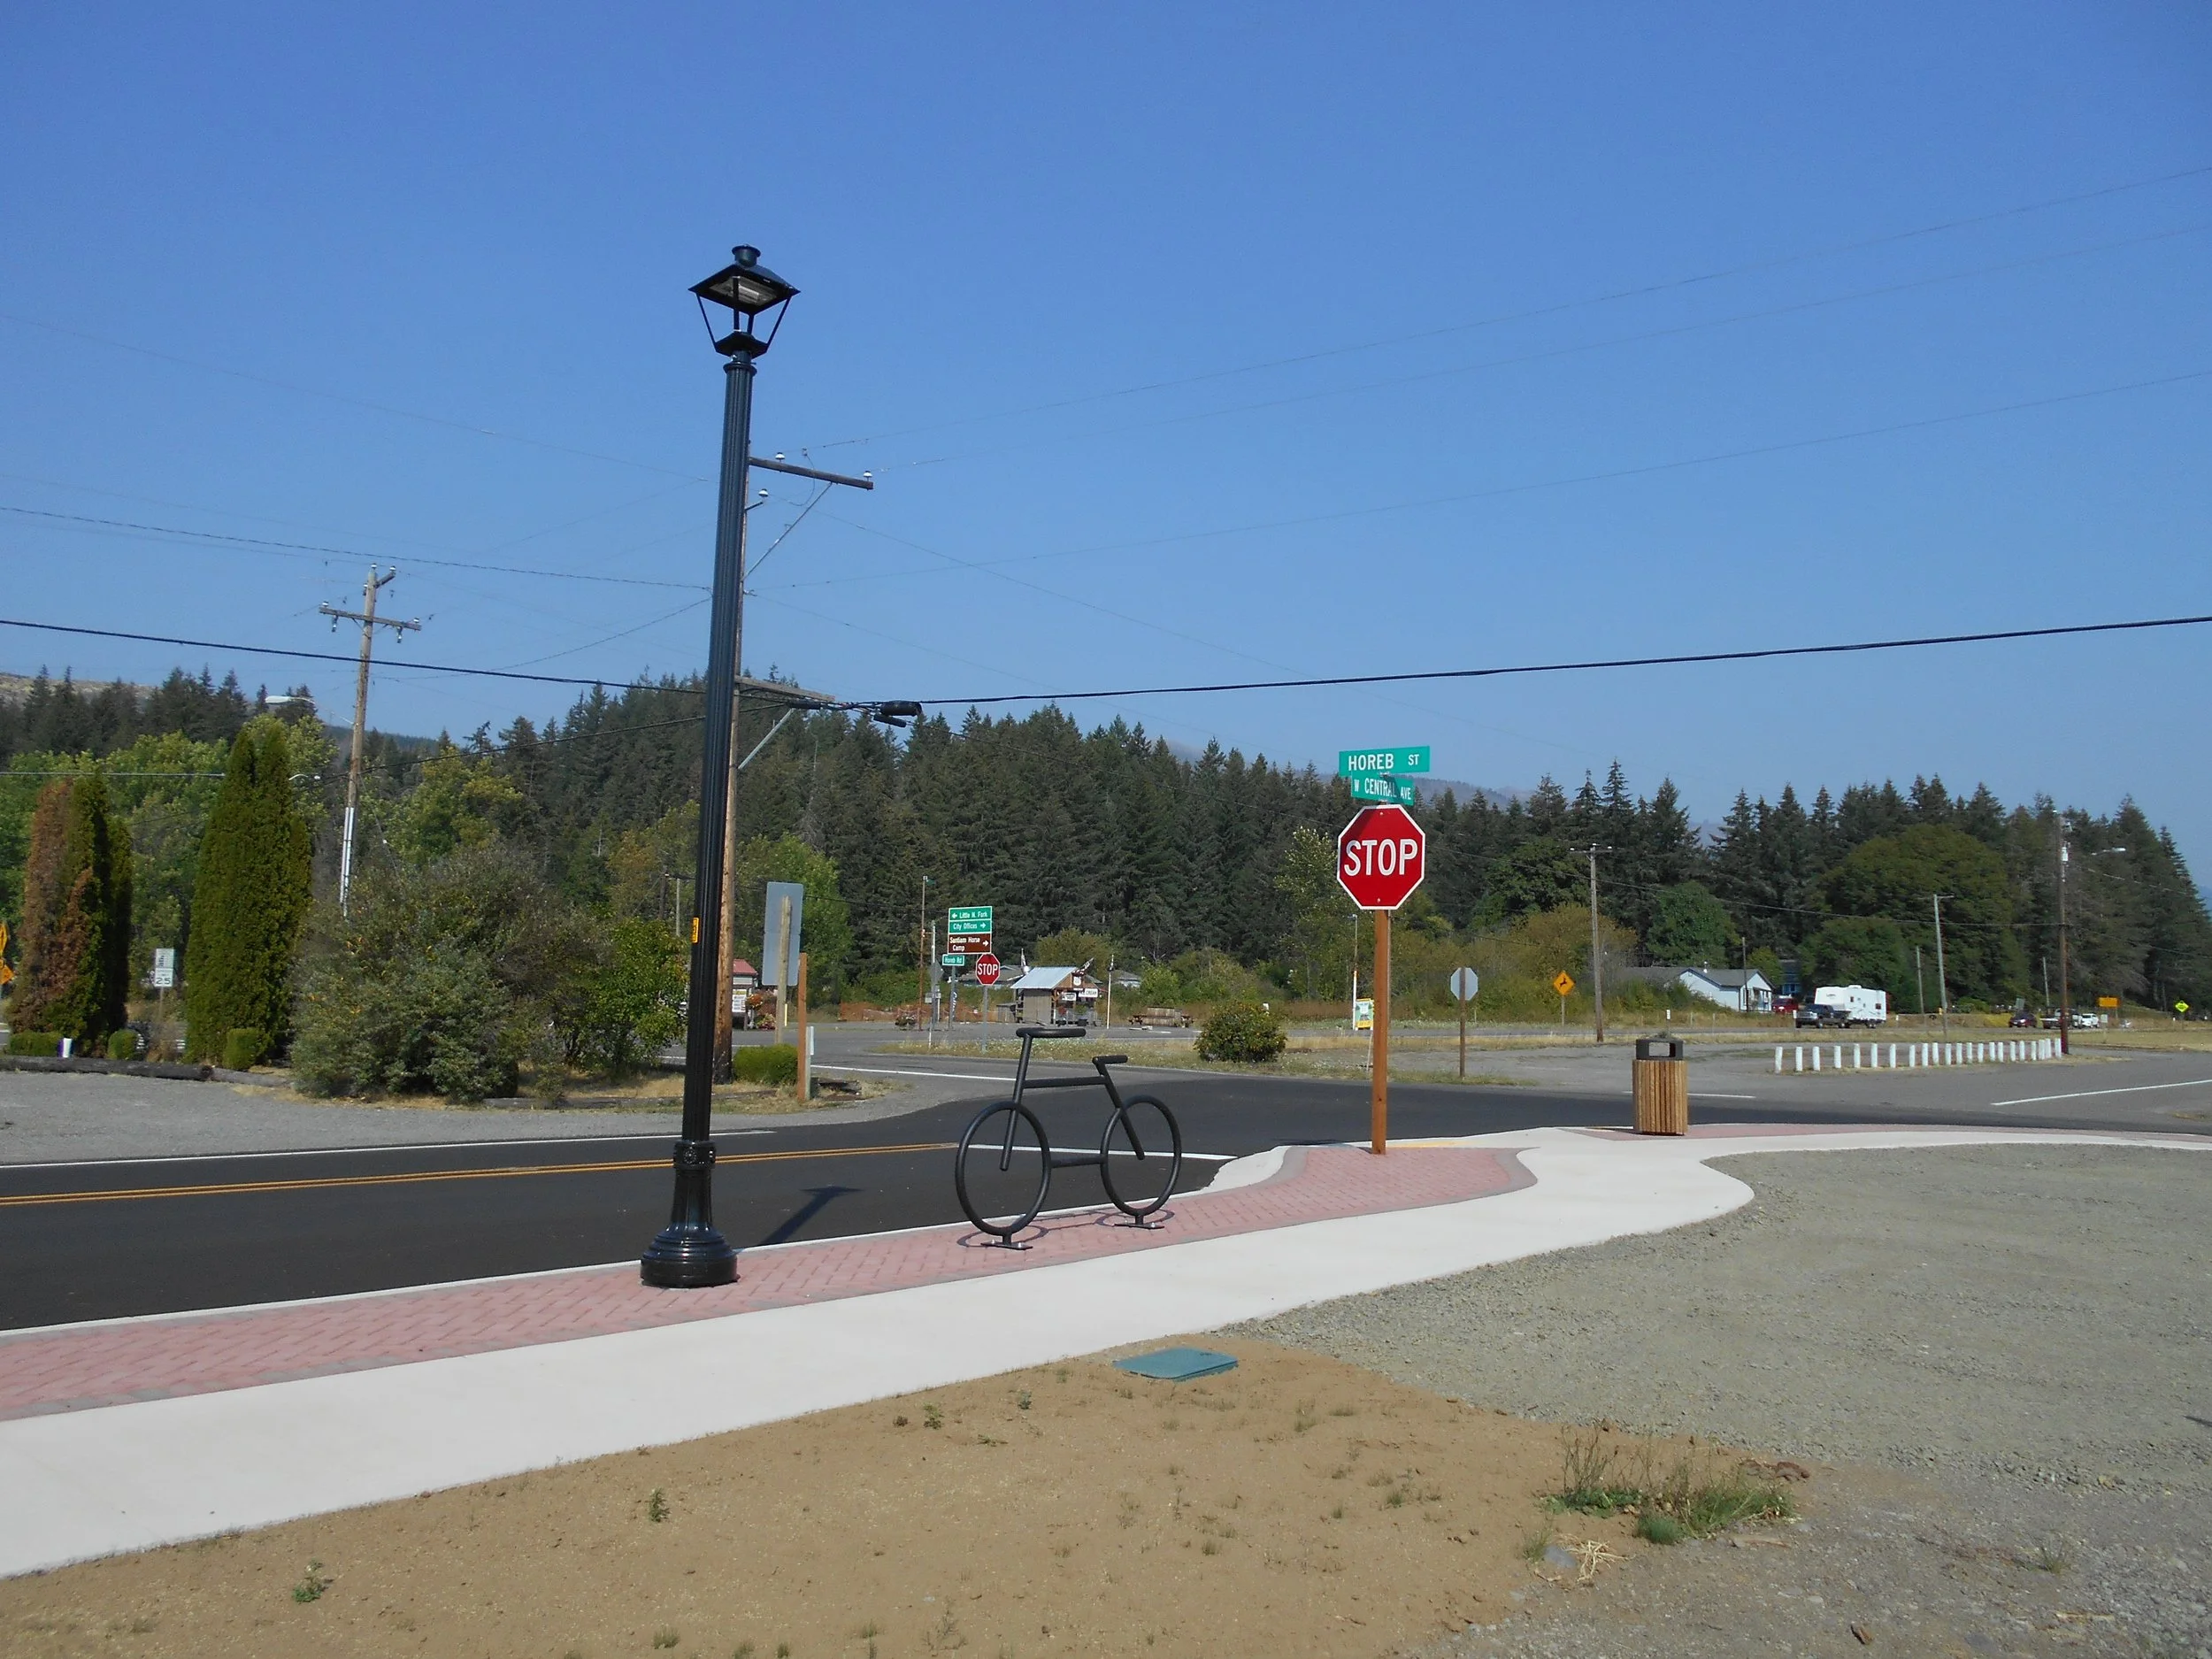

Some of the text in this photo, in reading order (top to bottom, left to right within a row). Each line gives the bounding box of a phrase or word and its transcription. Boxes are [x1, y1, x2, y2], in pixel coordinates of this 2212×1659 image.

[1348, 753, 1419, 772] HOREB ST
[1354, 778, 1411, 800] W CENTRAL AVE
[1344, 838, 1418, 877] STOP
[978, 964, 998, 975] STOP
